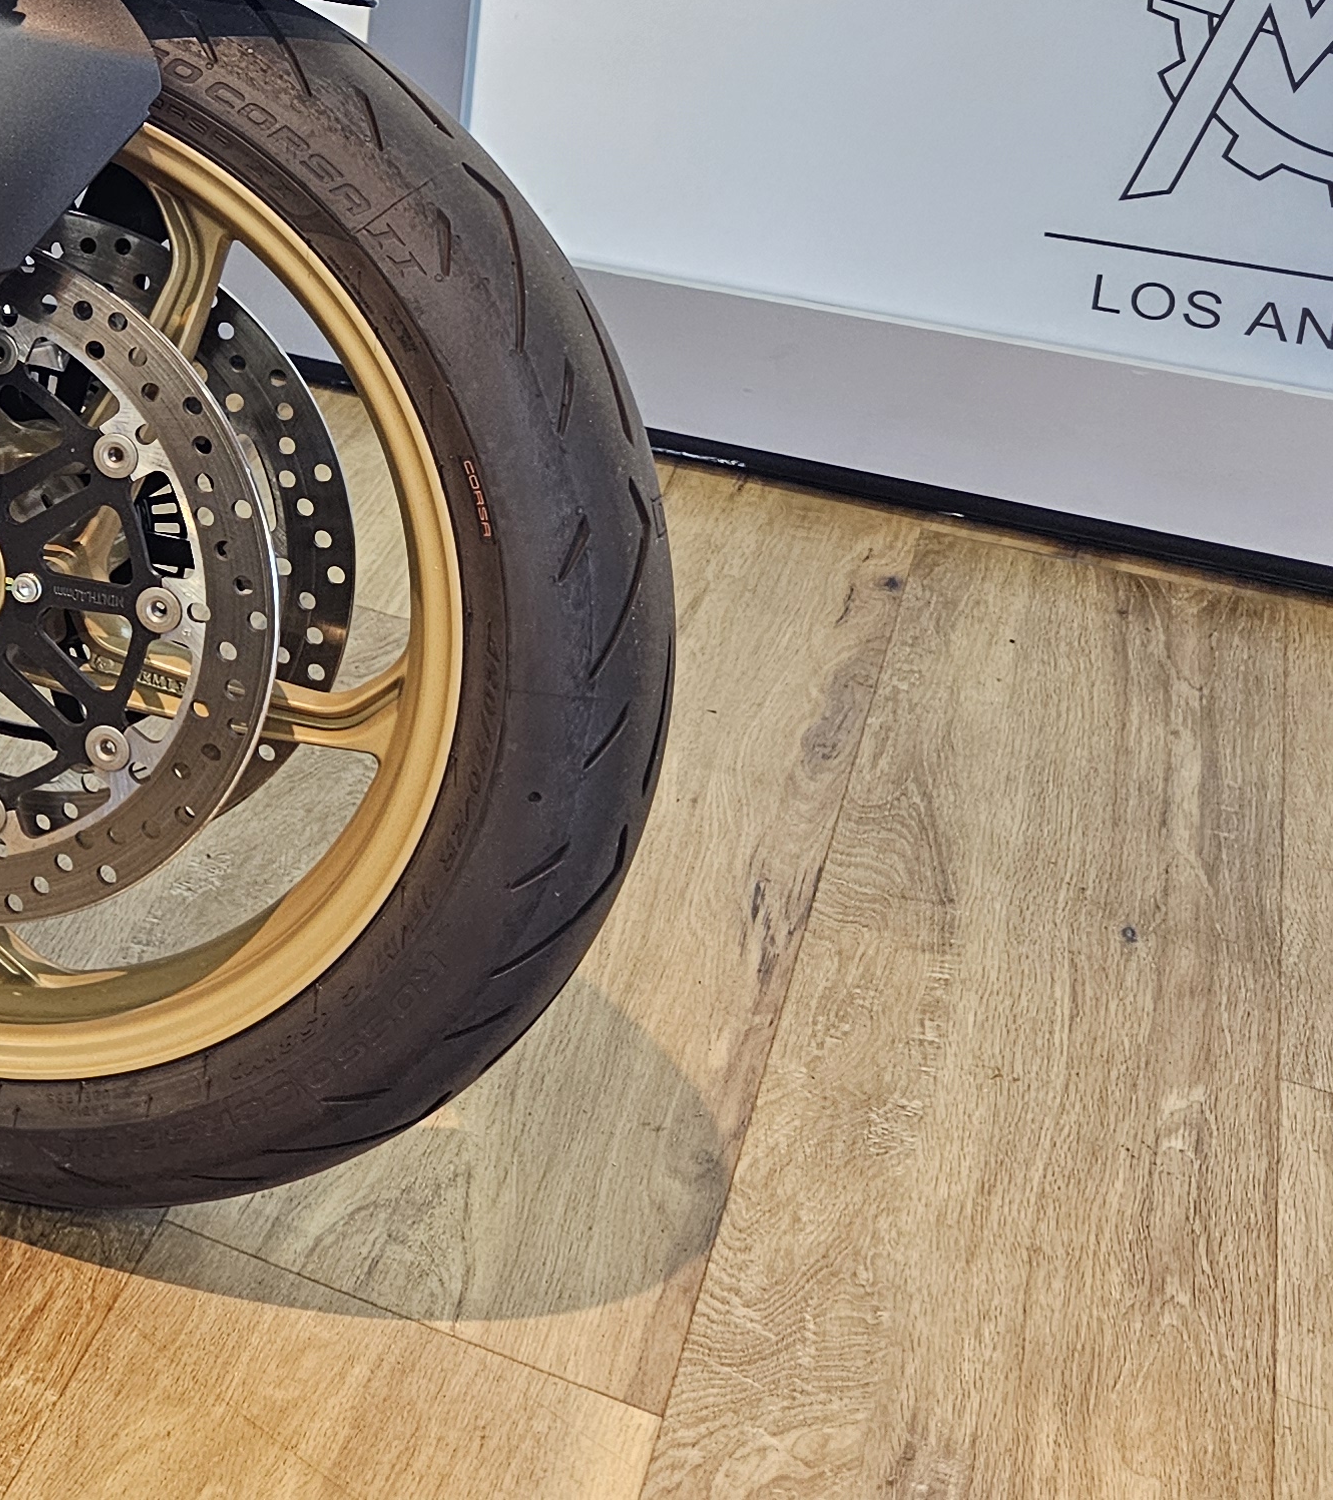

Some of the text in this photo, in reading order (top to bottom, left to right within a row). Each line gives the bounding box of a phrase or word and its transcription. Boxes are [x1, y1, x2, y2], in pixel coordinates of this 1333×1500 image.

[204, 81, 372, 218] CORSA
[1091, 273, 1223, 330] LOS
[463, 460, 492, 537] CORSA
